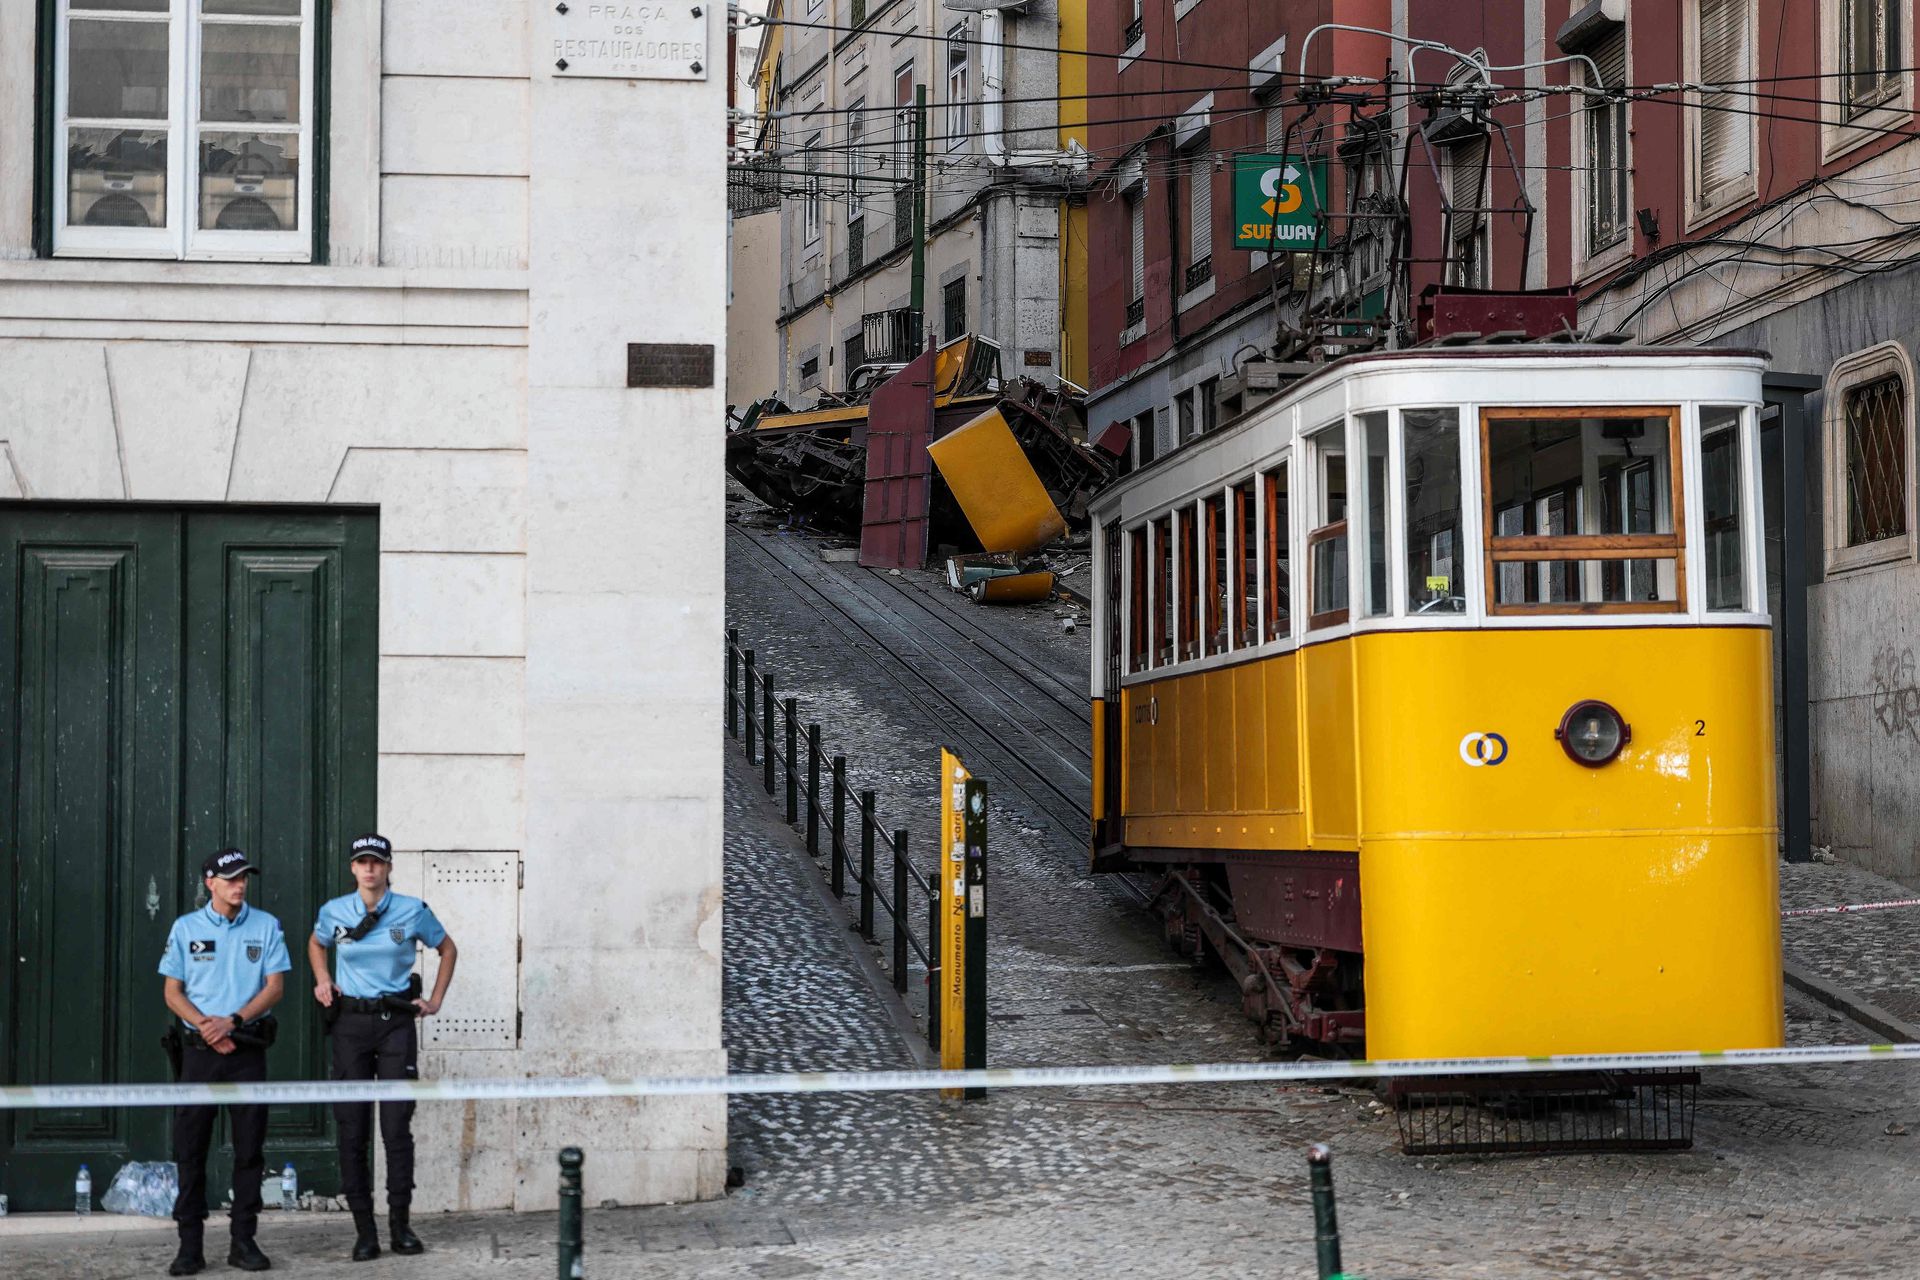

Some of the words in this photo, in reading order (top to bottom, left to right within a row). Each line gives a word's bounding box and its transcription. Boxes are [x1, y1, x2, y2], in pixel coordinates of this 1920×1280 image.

[588, 5, 667, 24] PRAÇA
[613, 25, 644, 35] DOS
[553, 39, 703, 60] RESTAURADORES
[1238, 223, 1324, 241] SUBWAY
[1694, 719, 1706, 736] 2
[952, 860, 961, 916] Nanal
[953, 924, 961, 995] Monumento
